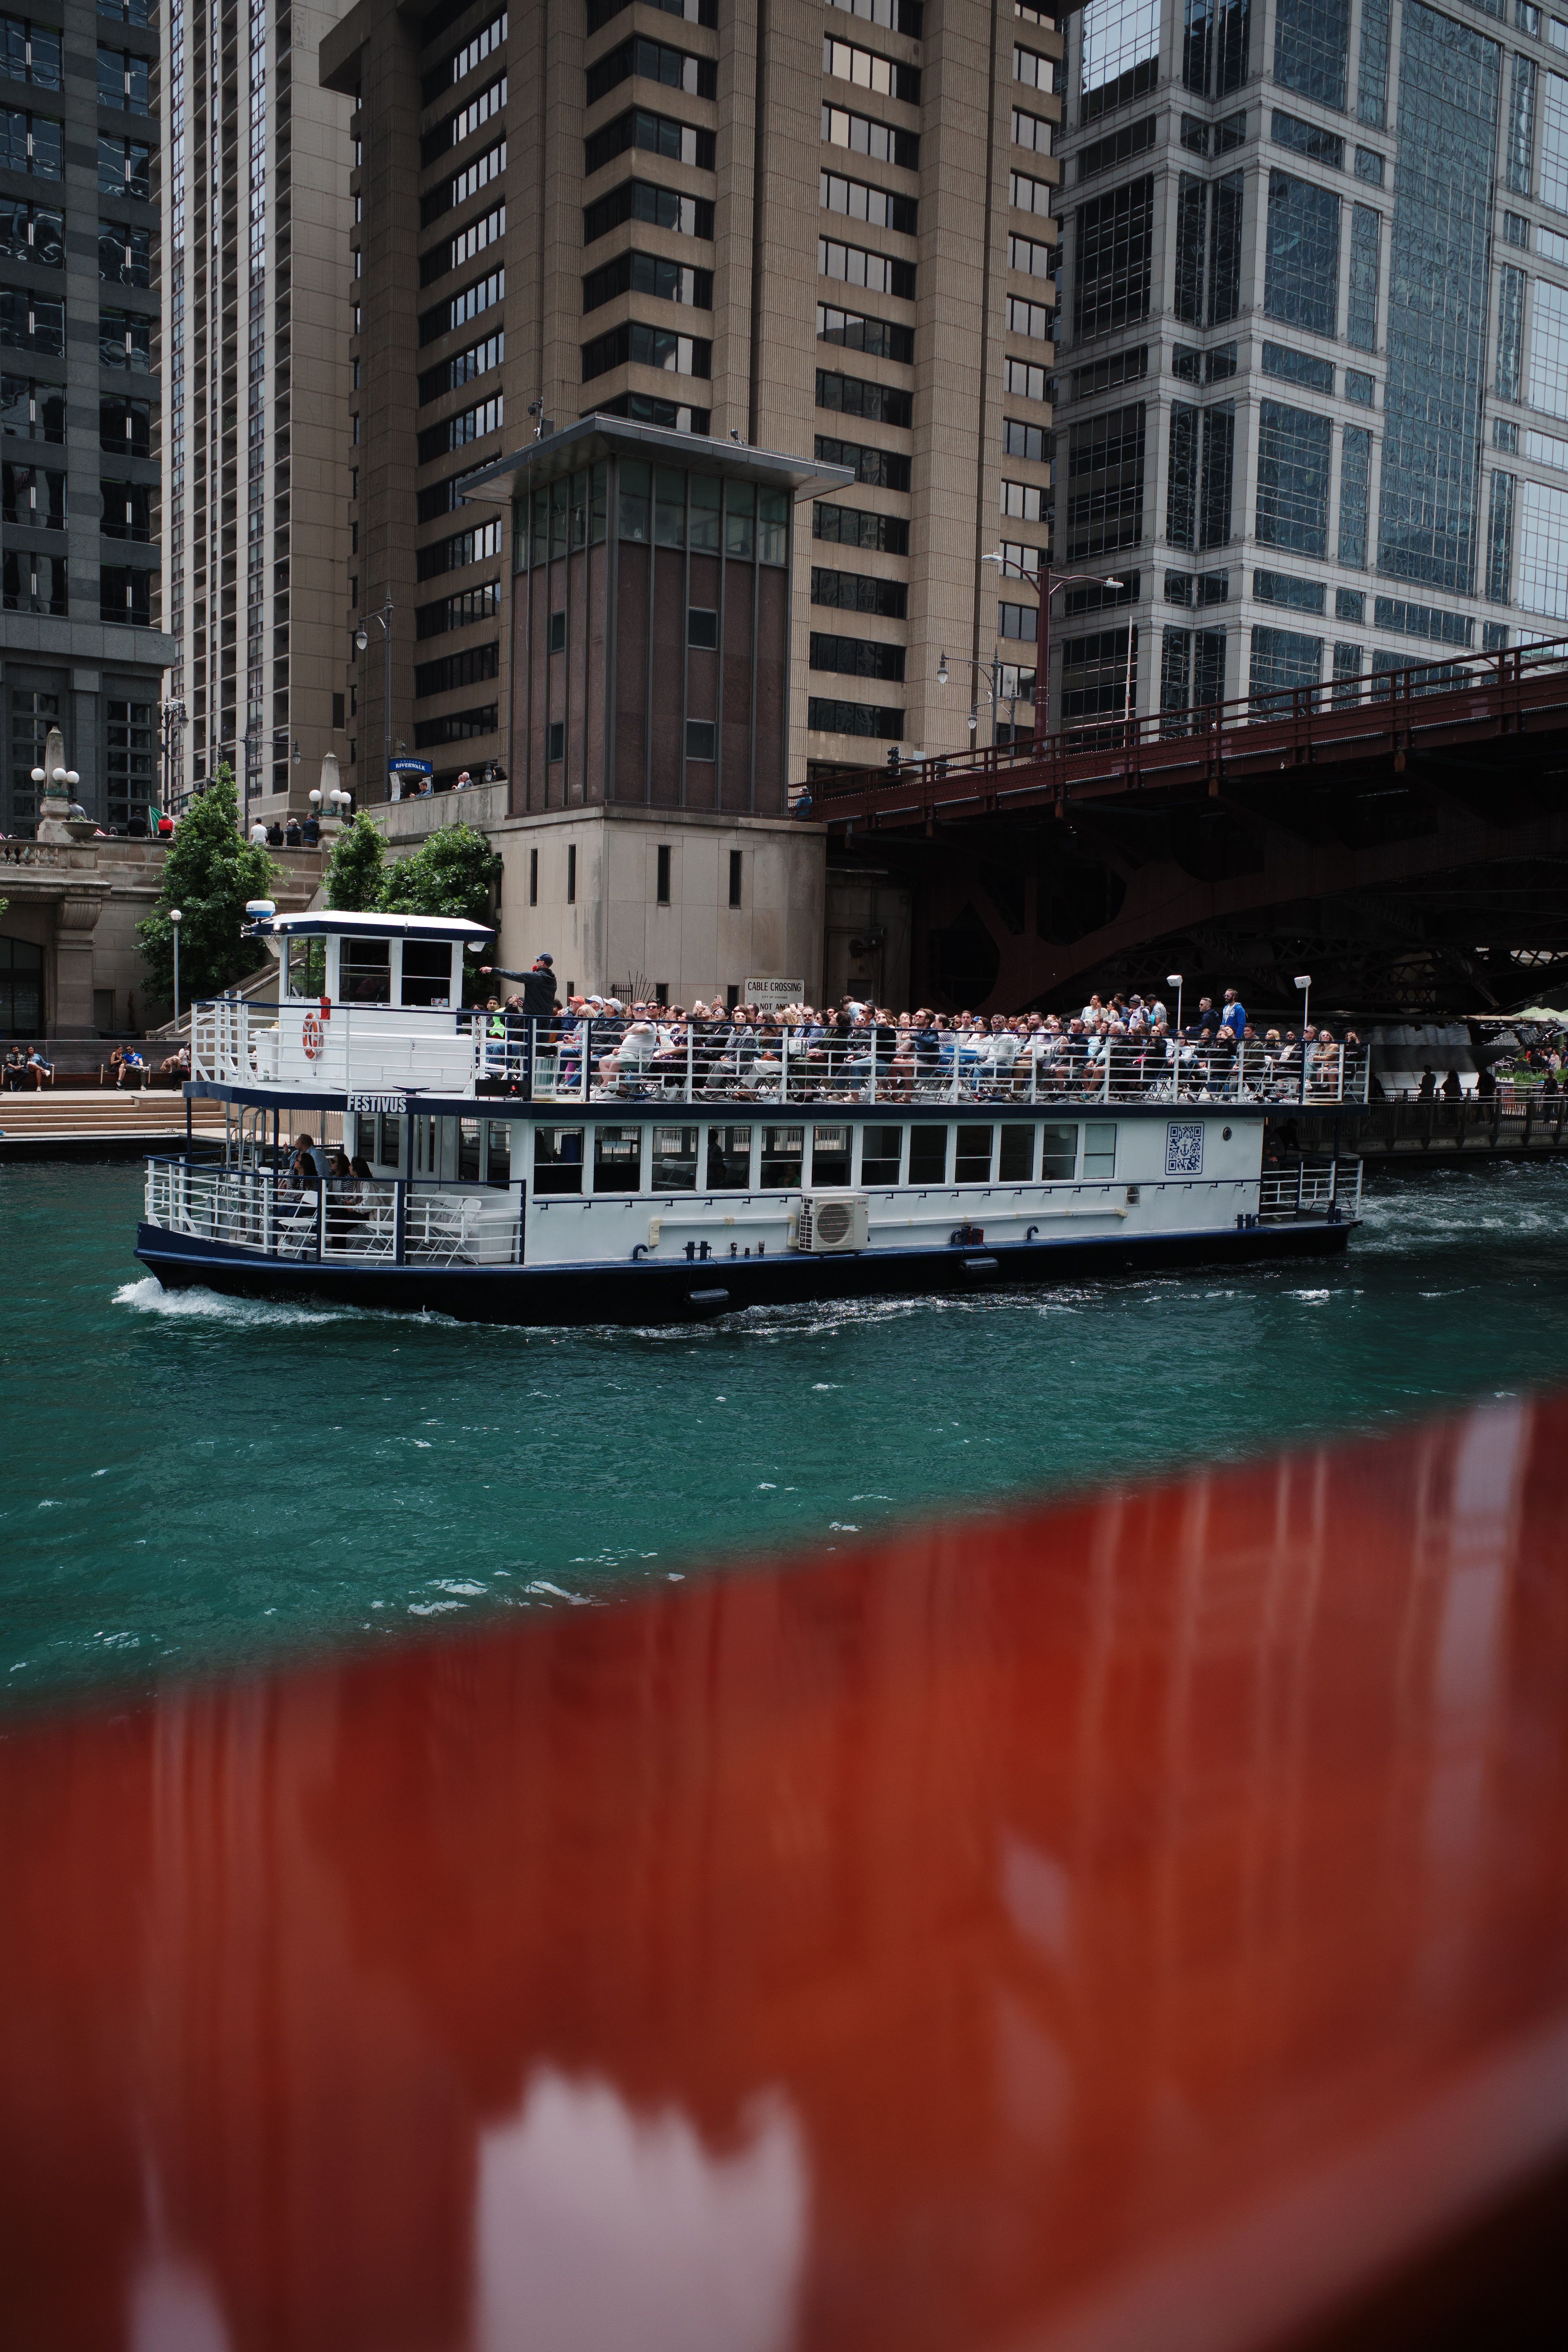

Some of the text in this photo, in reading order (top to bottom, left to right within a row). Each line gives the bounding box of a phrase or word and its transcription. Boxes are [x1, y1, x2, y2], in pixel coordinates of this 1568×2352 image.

[748, 982, 801, 992] CABLE CROSSING
[347, 1096, 407, 1113] FESTIVUS
